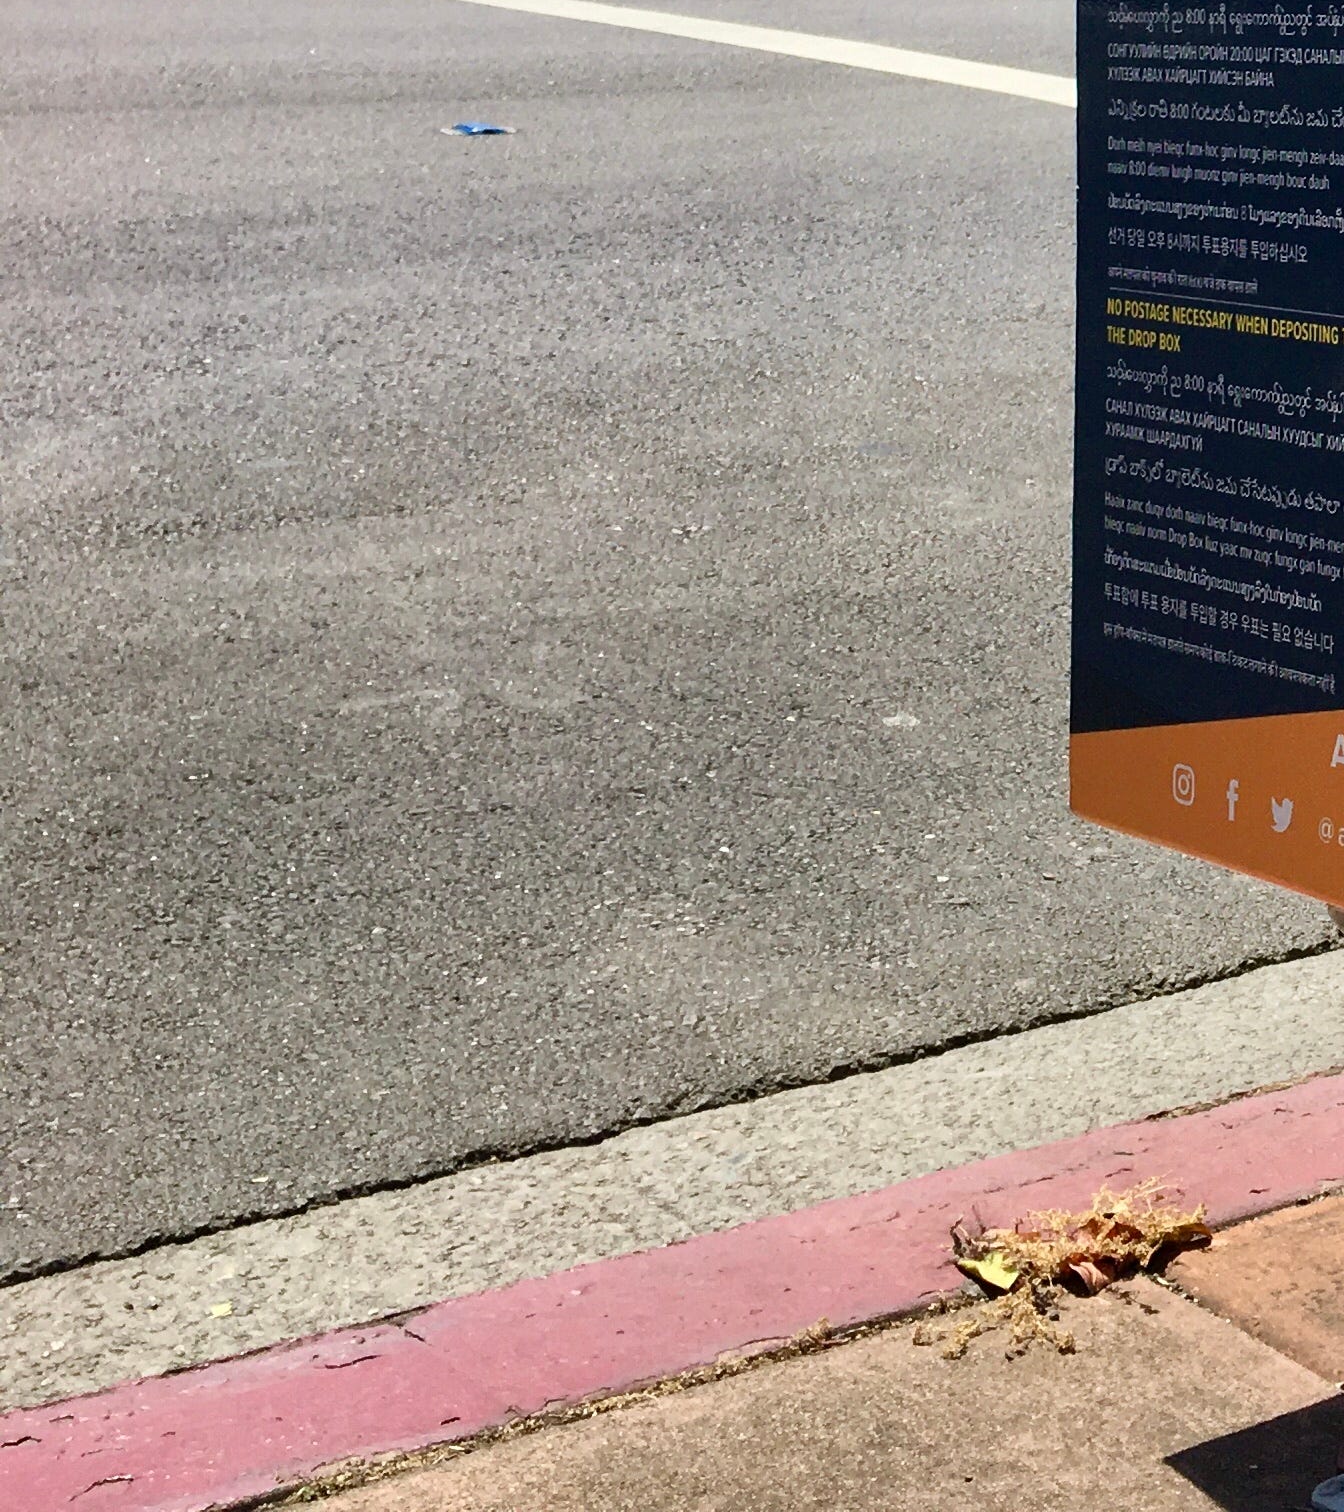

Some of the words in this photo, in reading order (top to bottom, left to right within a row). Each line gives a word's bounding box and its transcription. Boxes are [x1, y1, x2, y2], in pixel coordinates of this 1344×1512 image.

[1107, 297, 1122, 315] NO
[1124, 300, 1169, 322] POSTAGE
[1172, 306, 1233, 330] NECESSARY
[1235, 313, 1268, 335] WHEN
[1271, 318, 1338, 344] DEPOSITING
[1107, 325, 1125, 344] THE
[1128, 328, 1156, 348] DROP
[1159, 332, 1180, 352] BOX
